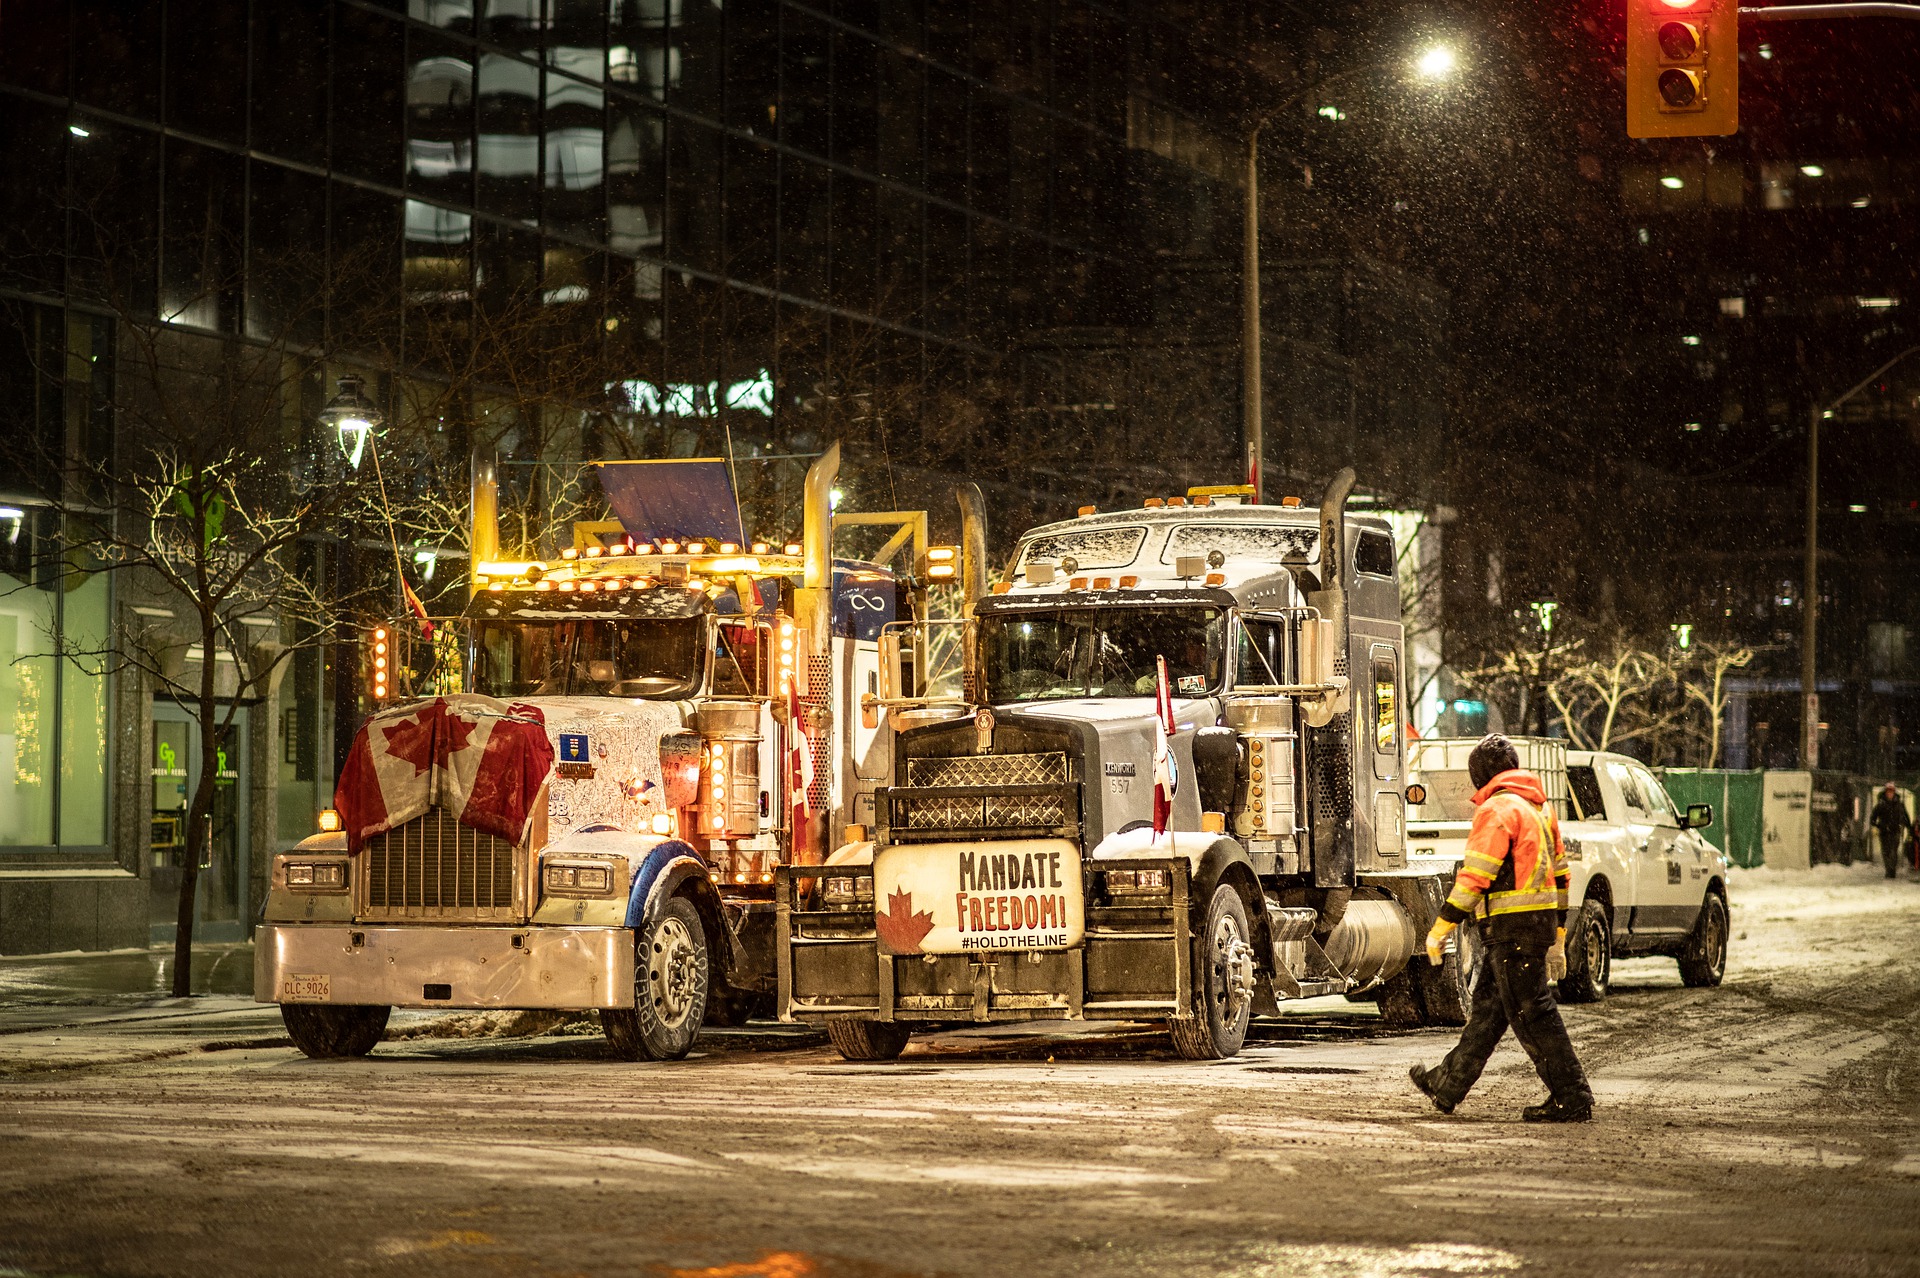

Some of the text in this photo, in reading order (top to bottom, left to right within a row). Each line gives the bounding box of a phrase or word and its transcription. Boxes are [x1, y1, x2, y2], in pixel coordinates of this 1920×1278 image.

[1111, 779, 1130, 794] 557
[959, 851, 1062, 891] MANDATE
[956, 892, 1066, 932] FREEDOM!
[962, 934, 1067, 949] #HOLDTHELINE
[284, 982, 329, 995] CLC-9026
[634, 921, 657, 1036] FREEDOM
